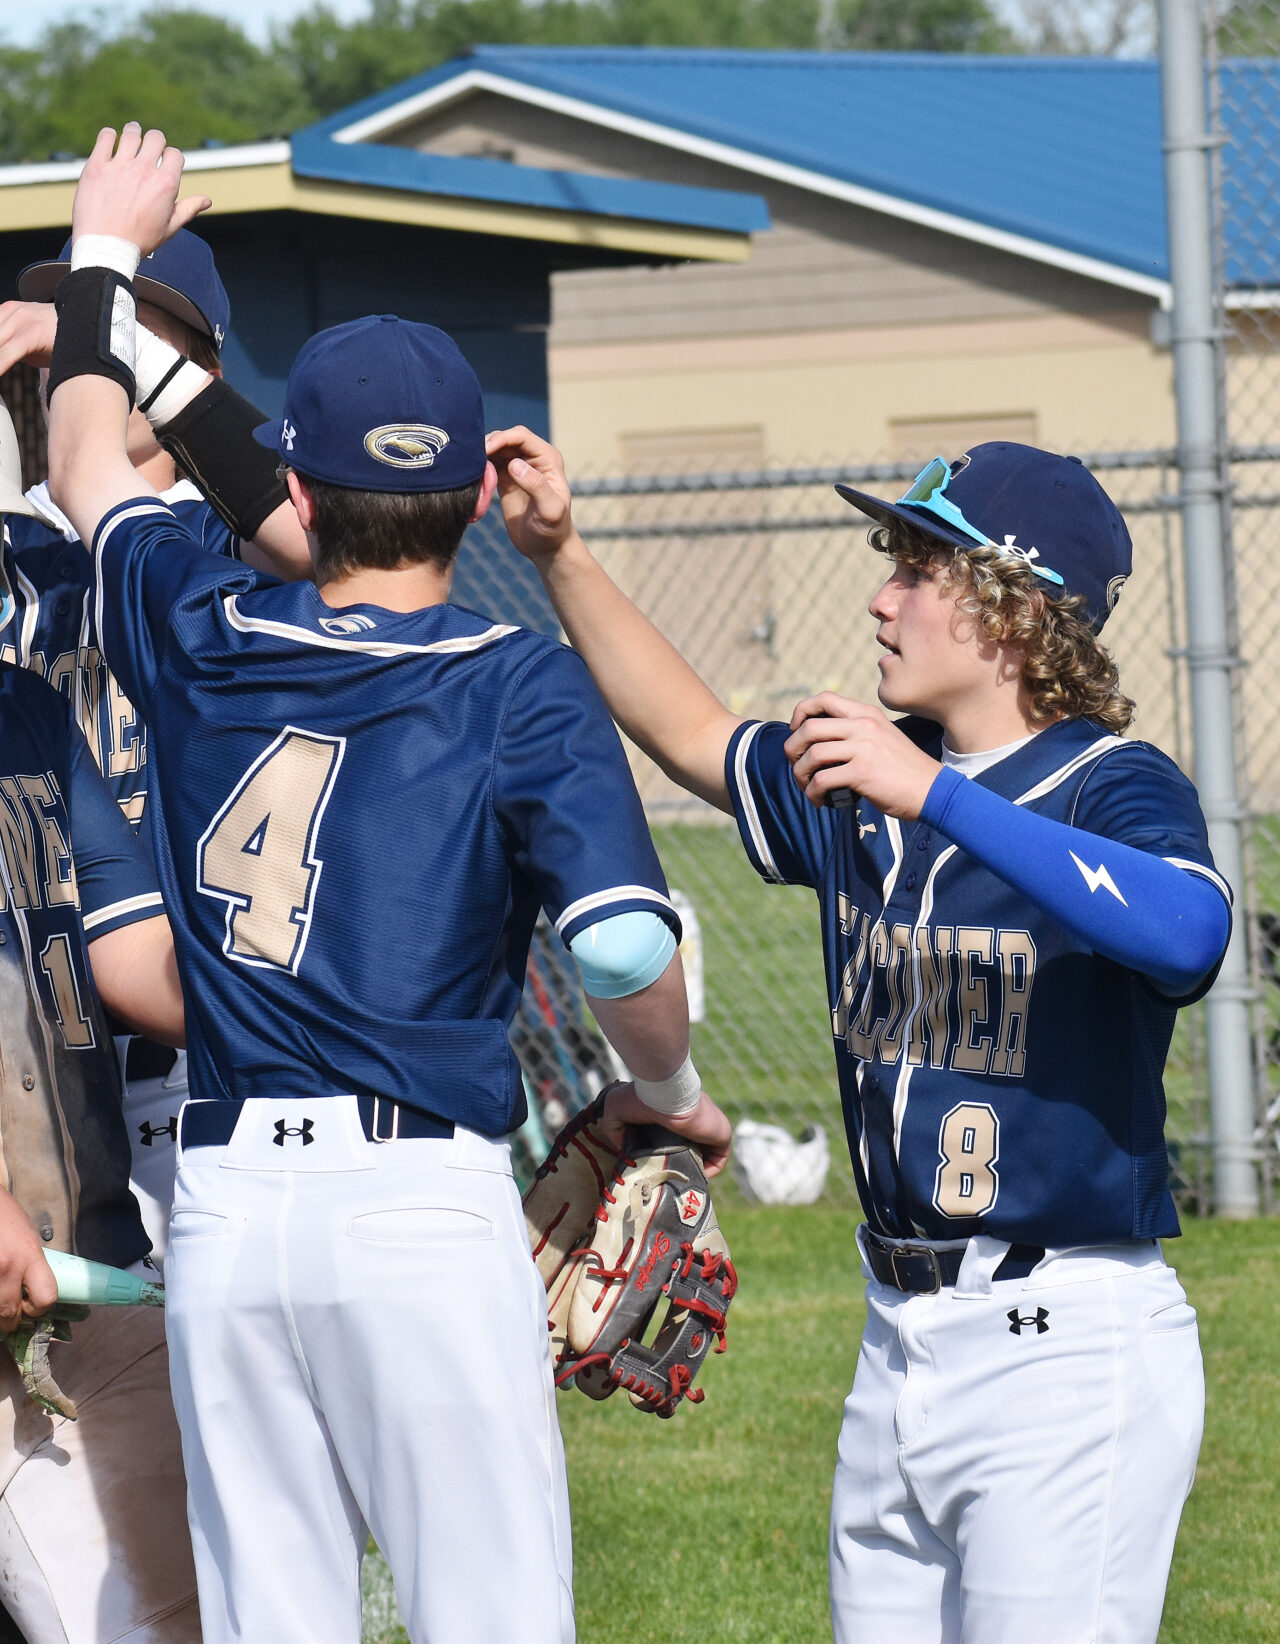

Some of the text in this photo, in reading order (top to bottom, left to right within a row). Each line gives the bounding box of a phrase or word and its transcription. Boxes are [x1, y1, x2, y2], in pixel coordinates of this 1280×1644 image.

[196, 724, 348, 977] 4
[39, 932, 96, 1050] 1
[932, 1101, 1000, 1219] 8
